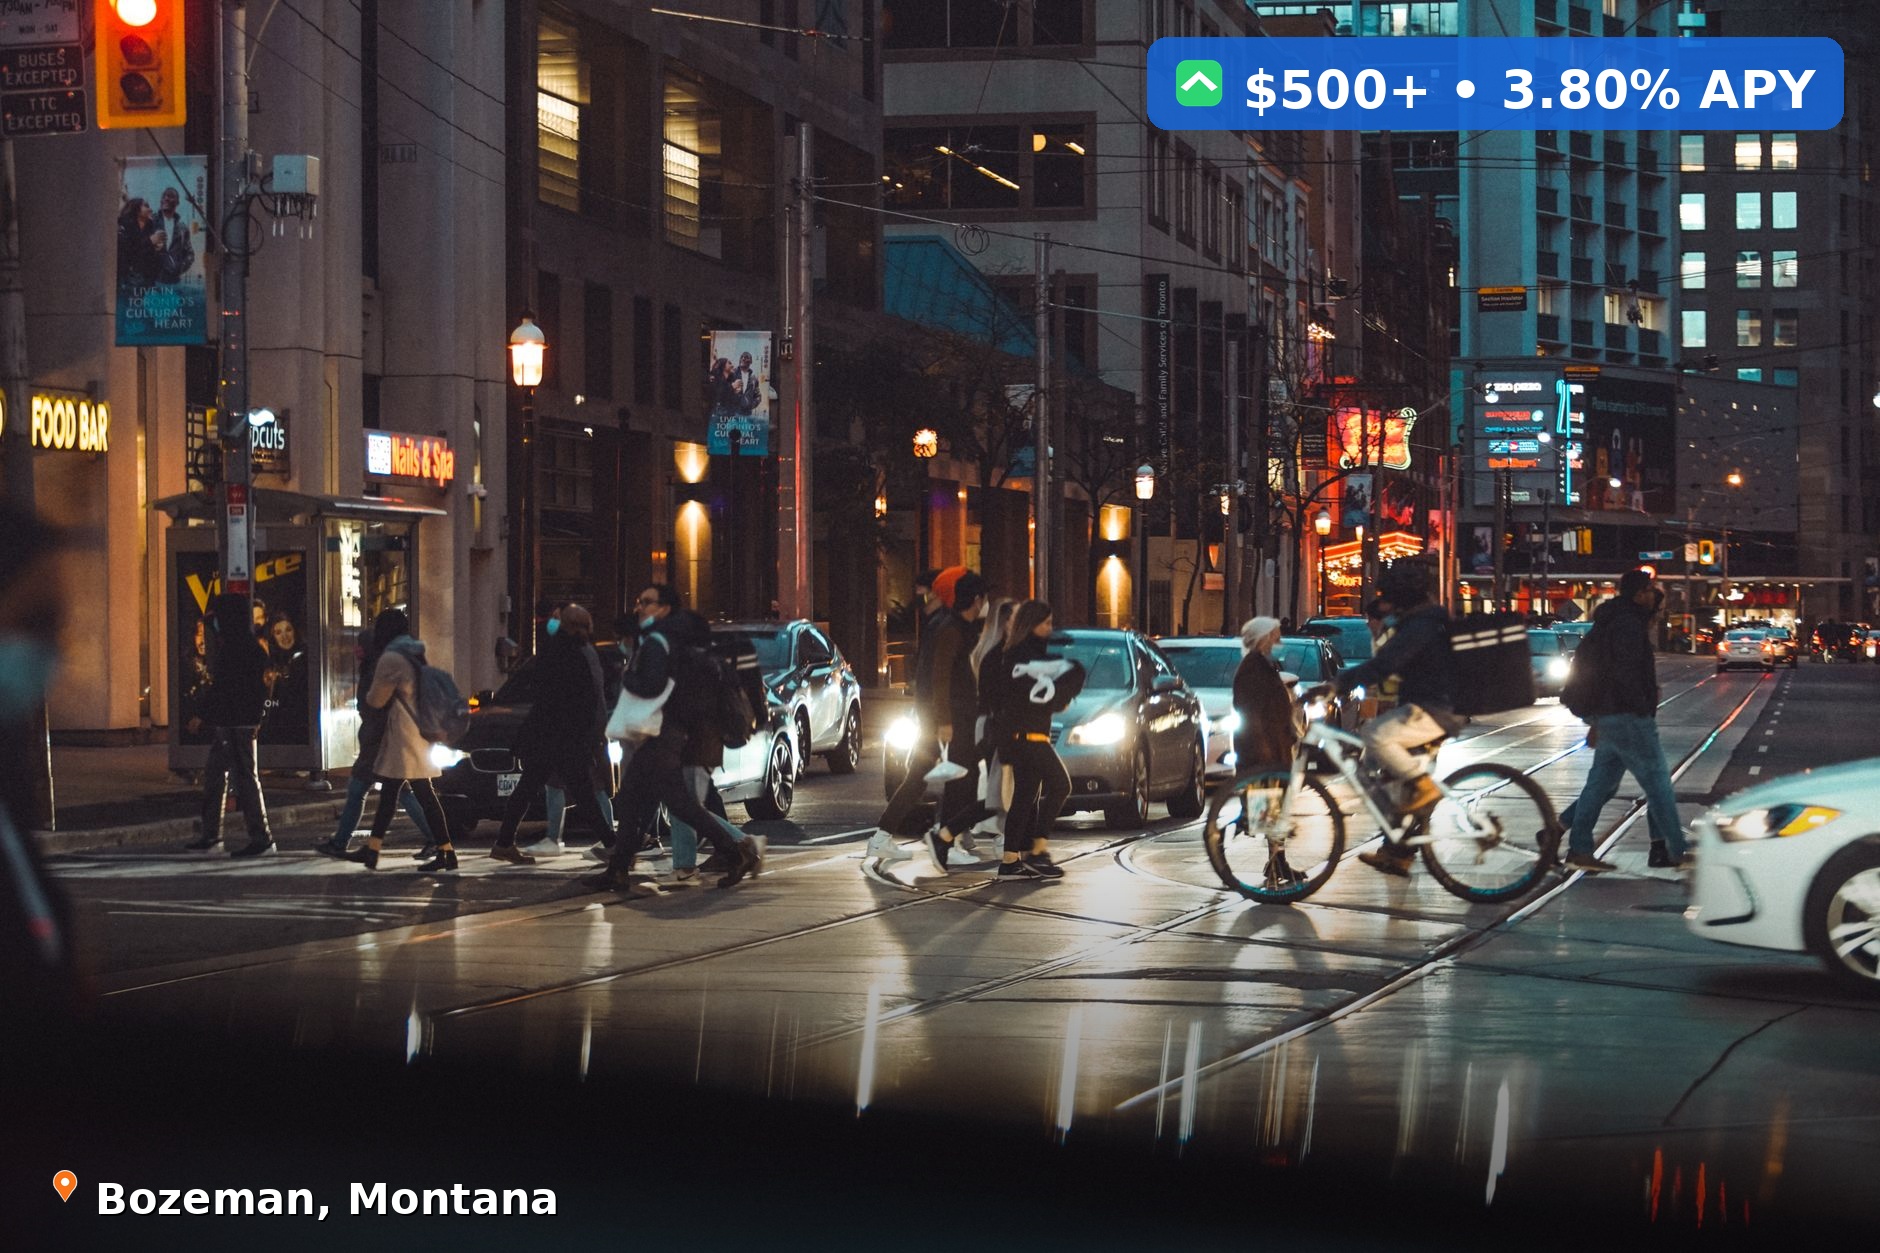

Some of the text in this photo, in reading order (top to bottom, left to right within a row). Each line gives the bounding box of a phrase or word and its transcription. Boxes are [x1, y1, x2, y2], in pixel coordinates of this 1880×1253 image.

[18, 52, 65, 68] BUSES
[6, 68, 78, 86] EXCEPTED
[29, 96, 57, 111] TTC
[8, 112, 81, 130] EXCEPTED
[133, 286, 174, 297] LIVE IN
[1158, 281, 1167, 316] Toronto
[128, 296, 195, 308] TORONTO'S
[126, 308, 186, 319] CULTURAL
[154, 318, 193, 329] HEART
[1158, 331, 1167, 368] Services
[1158, 369, 1168, 400] Family
[1158, 402, 1167, 418] and
[31, 395, 77, 450] FOOD
[78, 400, 109, 453] BAR
[716, 422, 761, 431] TORONTO'S
[249, 420, 286, 454] pcuts
[391, 435, 455, 487] Nails & Spa
